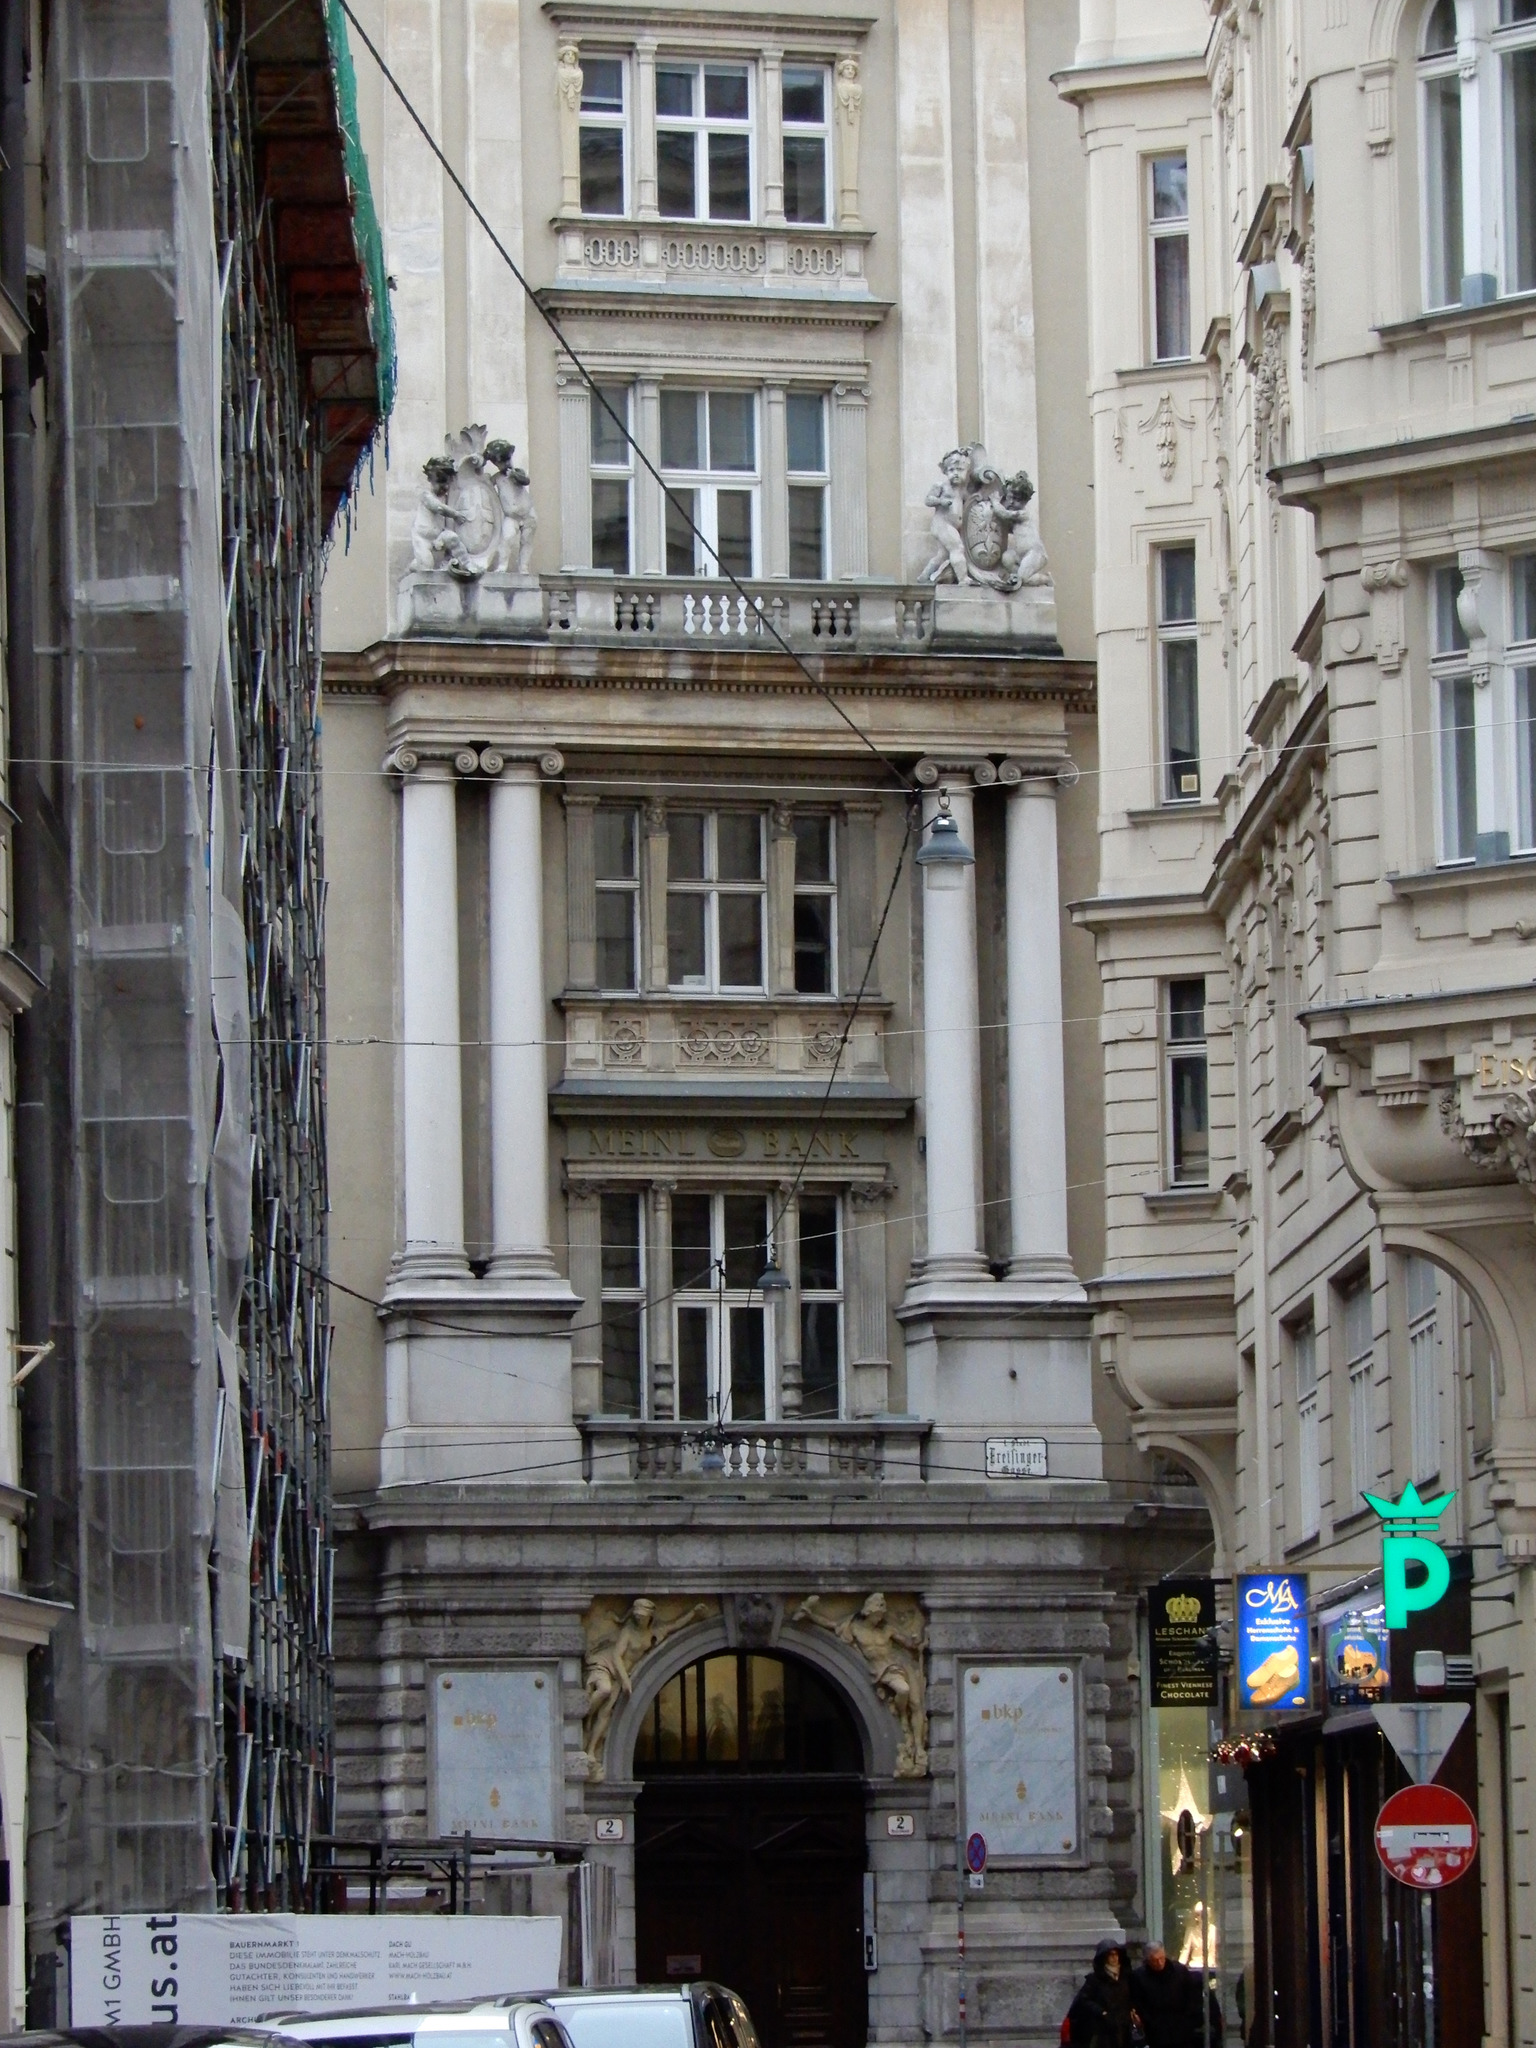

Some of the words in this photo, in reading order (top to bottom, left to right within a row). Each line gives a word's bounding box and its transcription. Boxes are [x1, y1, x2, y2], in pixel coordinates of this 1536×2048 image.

[588, 1129, 695, 1156] MEINL
[762, 1130, 859, 1157] BANK
[1383, 1537, 1450, 1629] P
[1255, 1618, 1291, 1626] Exklusive
[1155, 1627, 1212, 1636] LESCHAN
[1246, 1626, 1292, 1634] Herrenschuhe
[1293, 1626, 1300, 1634] &
[1250, 1635, 1297, 1643] Damenschuhe
[1160, 1690, 1209, 1699] CHOCOLATE
[993, 1704, 1024, 1723] bkp
[1028, 1811, 1064, 1821] BANK
[502, 1819, 538, 1829] BANK
[605, 1820, 614, 1833] 2
[896, 1816, 905, 1829] 2
[229, 1940, 294, 1949] BAUERNMARKT
[103, 1916, 121, 1990] GMBH
[229, 1952, 254, 1960] DIESE
[229, 1984, 258, 1992] HABEN
[260, 1983, 280, 1991] SICH
[258, 1994, 275, 2002] GILT
